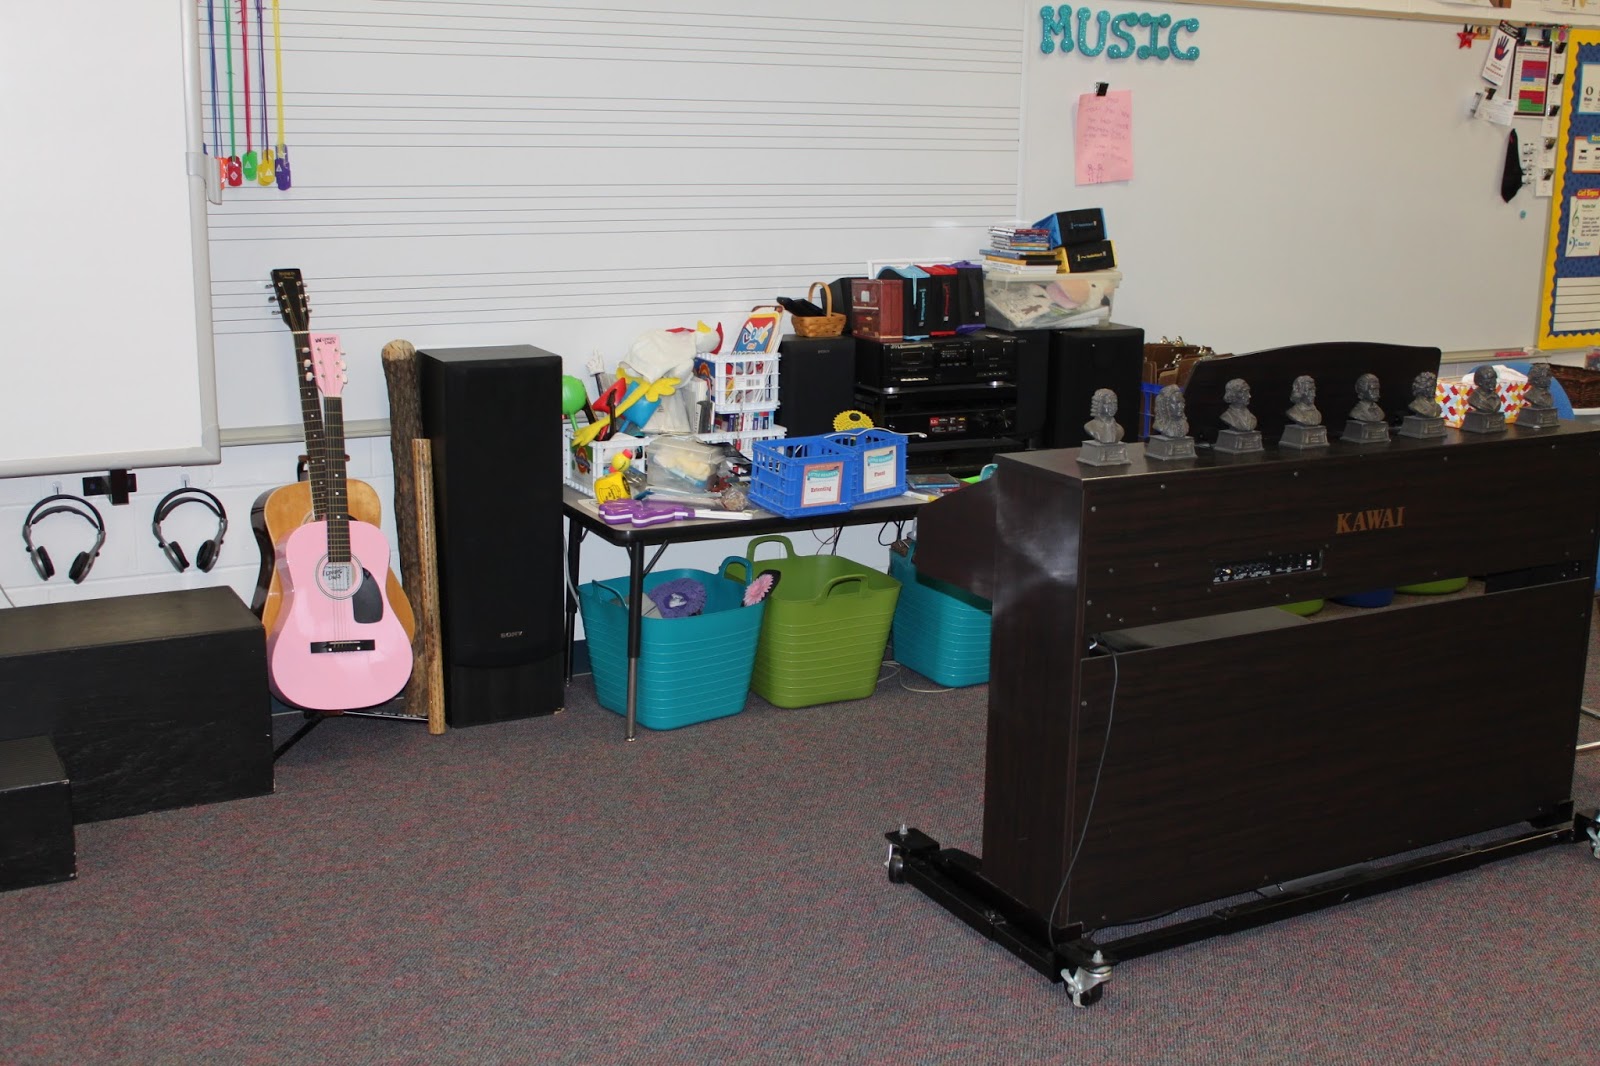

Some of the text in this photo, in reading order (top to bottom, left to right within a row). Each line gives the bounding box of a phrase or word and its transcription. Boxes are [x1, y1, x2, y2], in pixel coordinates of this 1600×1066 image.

[1040, 5, 1199, 61] MUSIC
[1336, 507, 1405, 534] KAWAI
[500, 630, 523, 639] SONY
